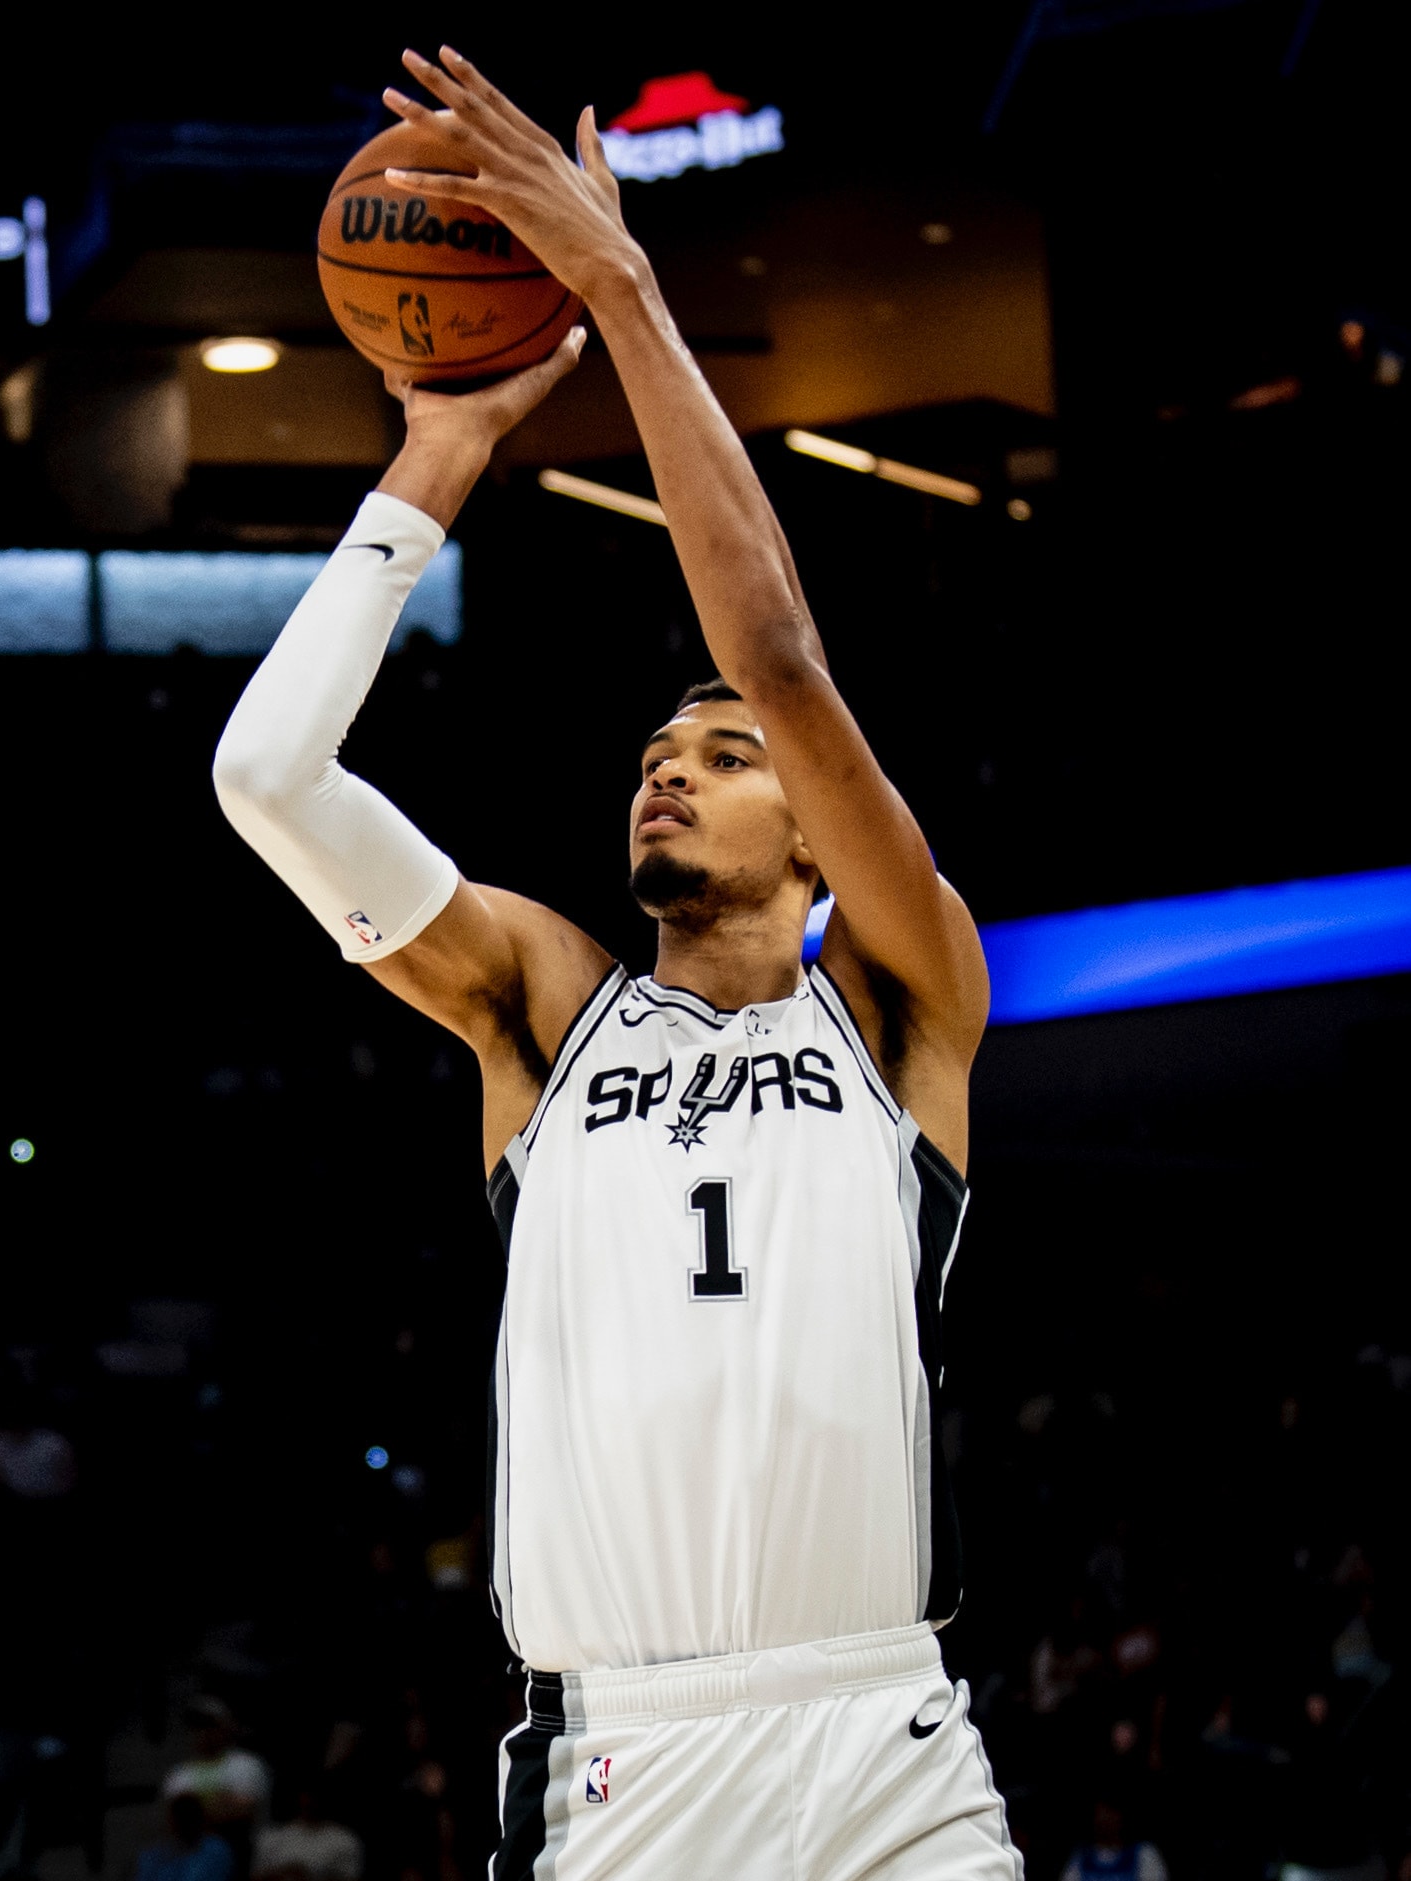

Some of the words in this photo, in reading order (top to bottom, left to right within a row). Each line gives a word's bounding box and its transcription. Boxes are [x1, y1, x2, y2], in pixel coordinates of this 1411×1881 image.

[341, 195, 512, 260] Wilson
[585, 1047, 844, 1153] SPURS
[685, 1176, 750, 1302] 1
